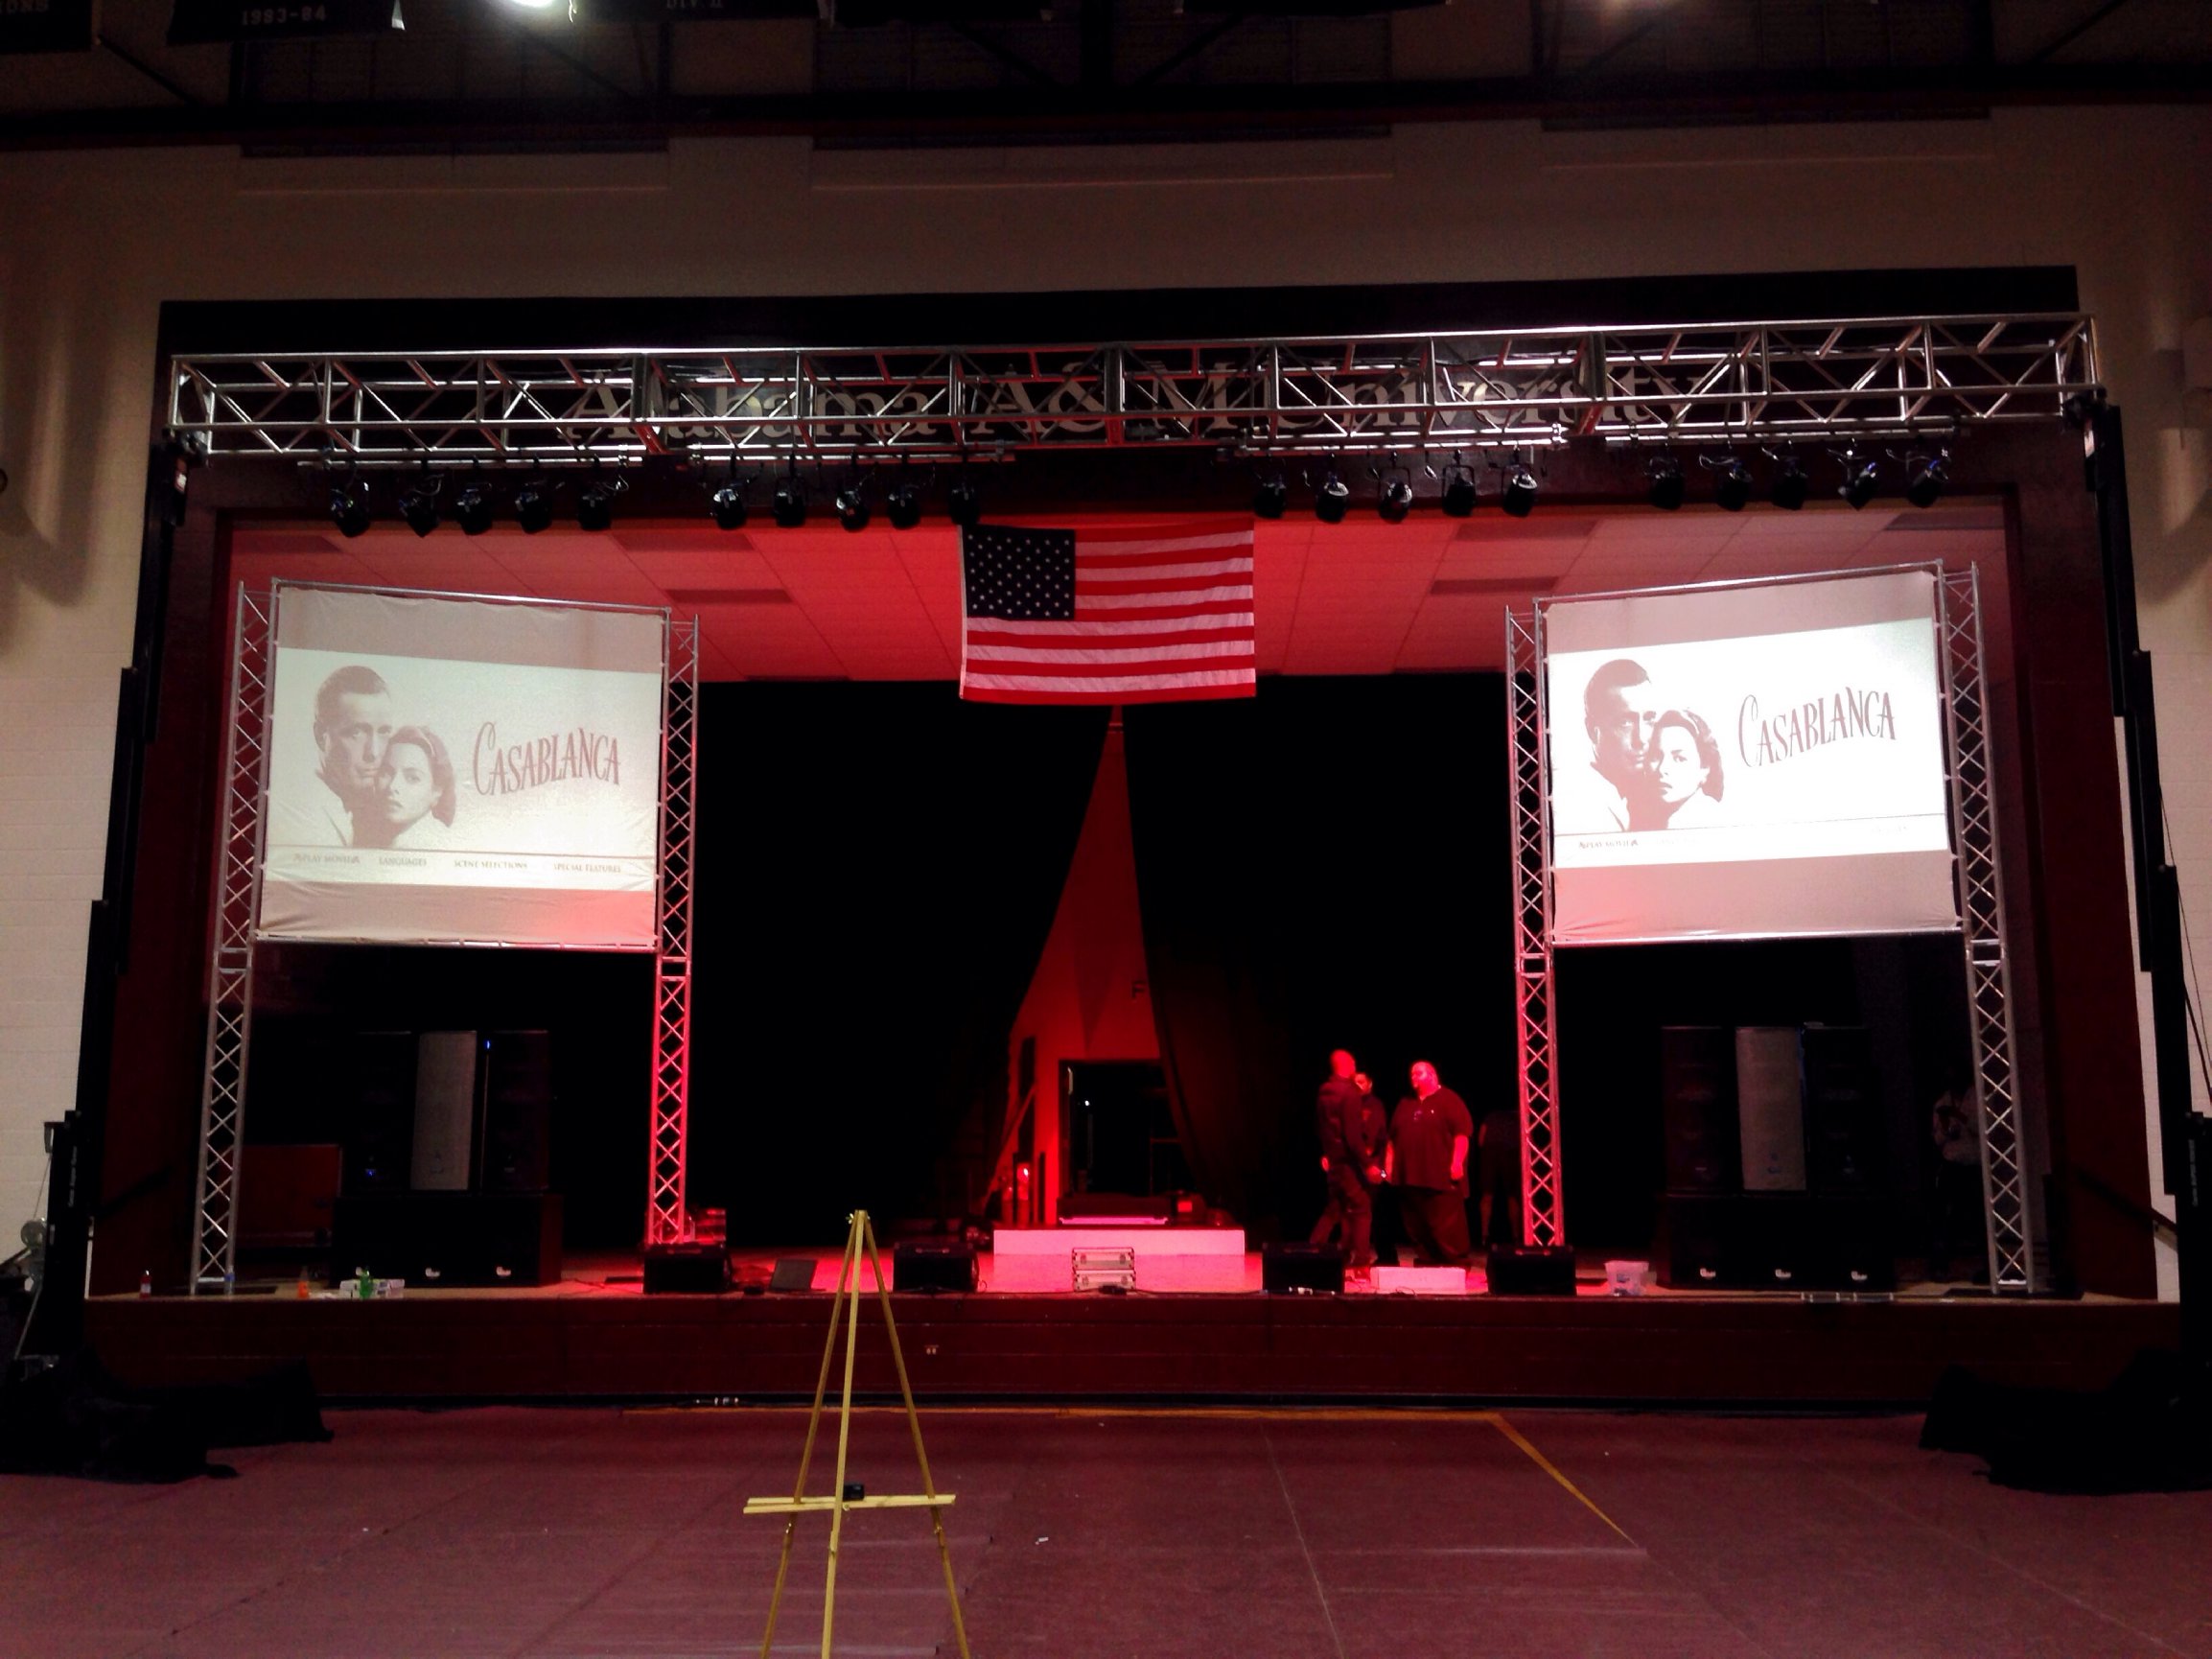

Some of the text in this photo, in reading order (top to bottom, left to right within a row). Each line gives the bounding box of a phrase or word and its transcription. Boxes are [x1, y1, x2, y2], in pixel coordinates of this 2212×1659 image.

[557, 362, 938, 438] Alabama
[474, 721, 620, 796] CASABLANCA
[1738, 687, 1897, 767] CASABLANCA
